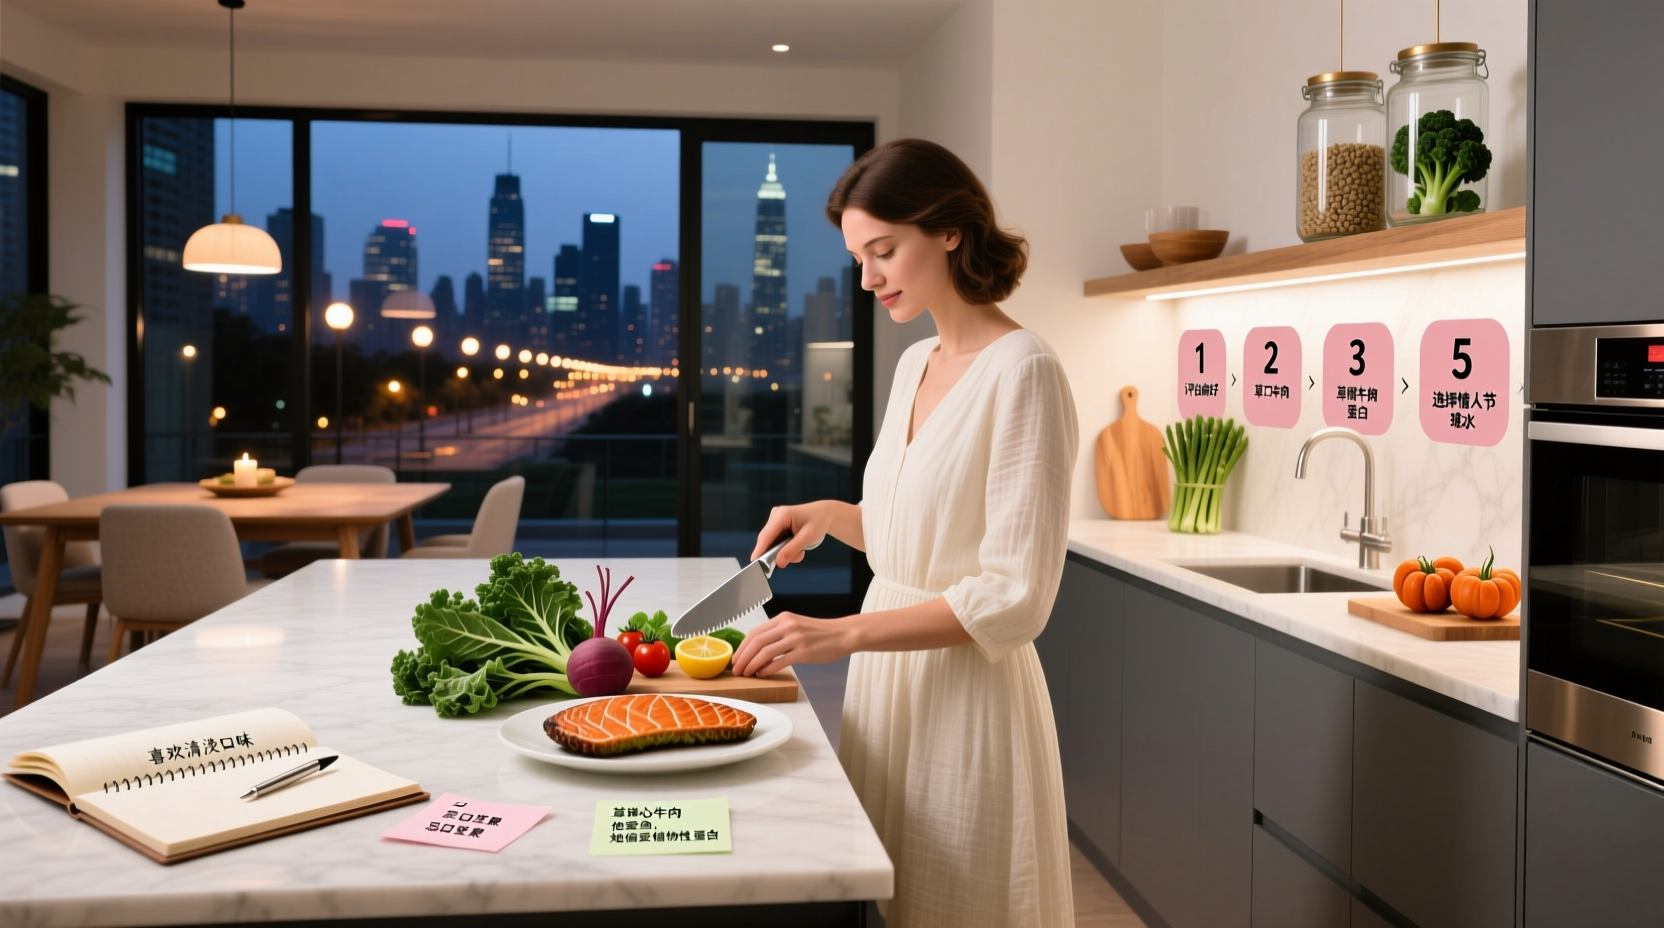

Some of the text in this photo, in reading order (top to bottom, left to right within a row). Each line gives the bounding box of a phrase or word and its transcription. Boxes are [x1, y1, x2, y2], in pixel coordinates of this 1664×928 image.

[1195, 342, 1204, 374] 1
[1264, 341, 1279, 374] 2
[1349, 338, 1366, 376] 3
[1451, 338, 1473, 380] 5
